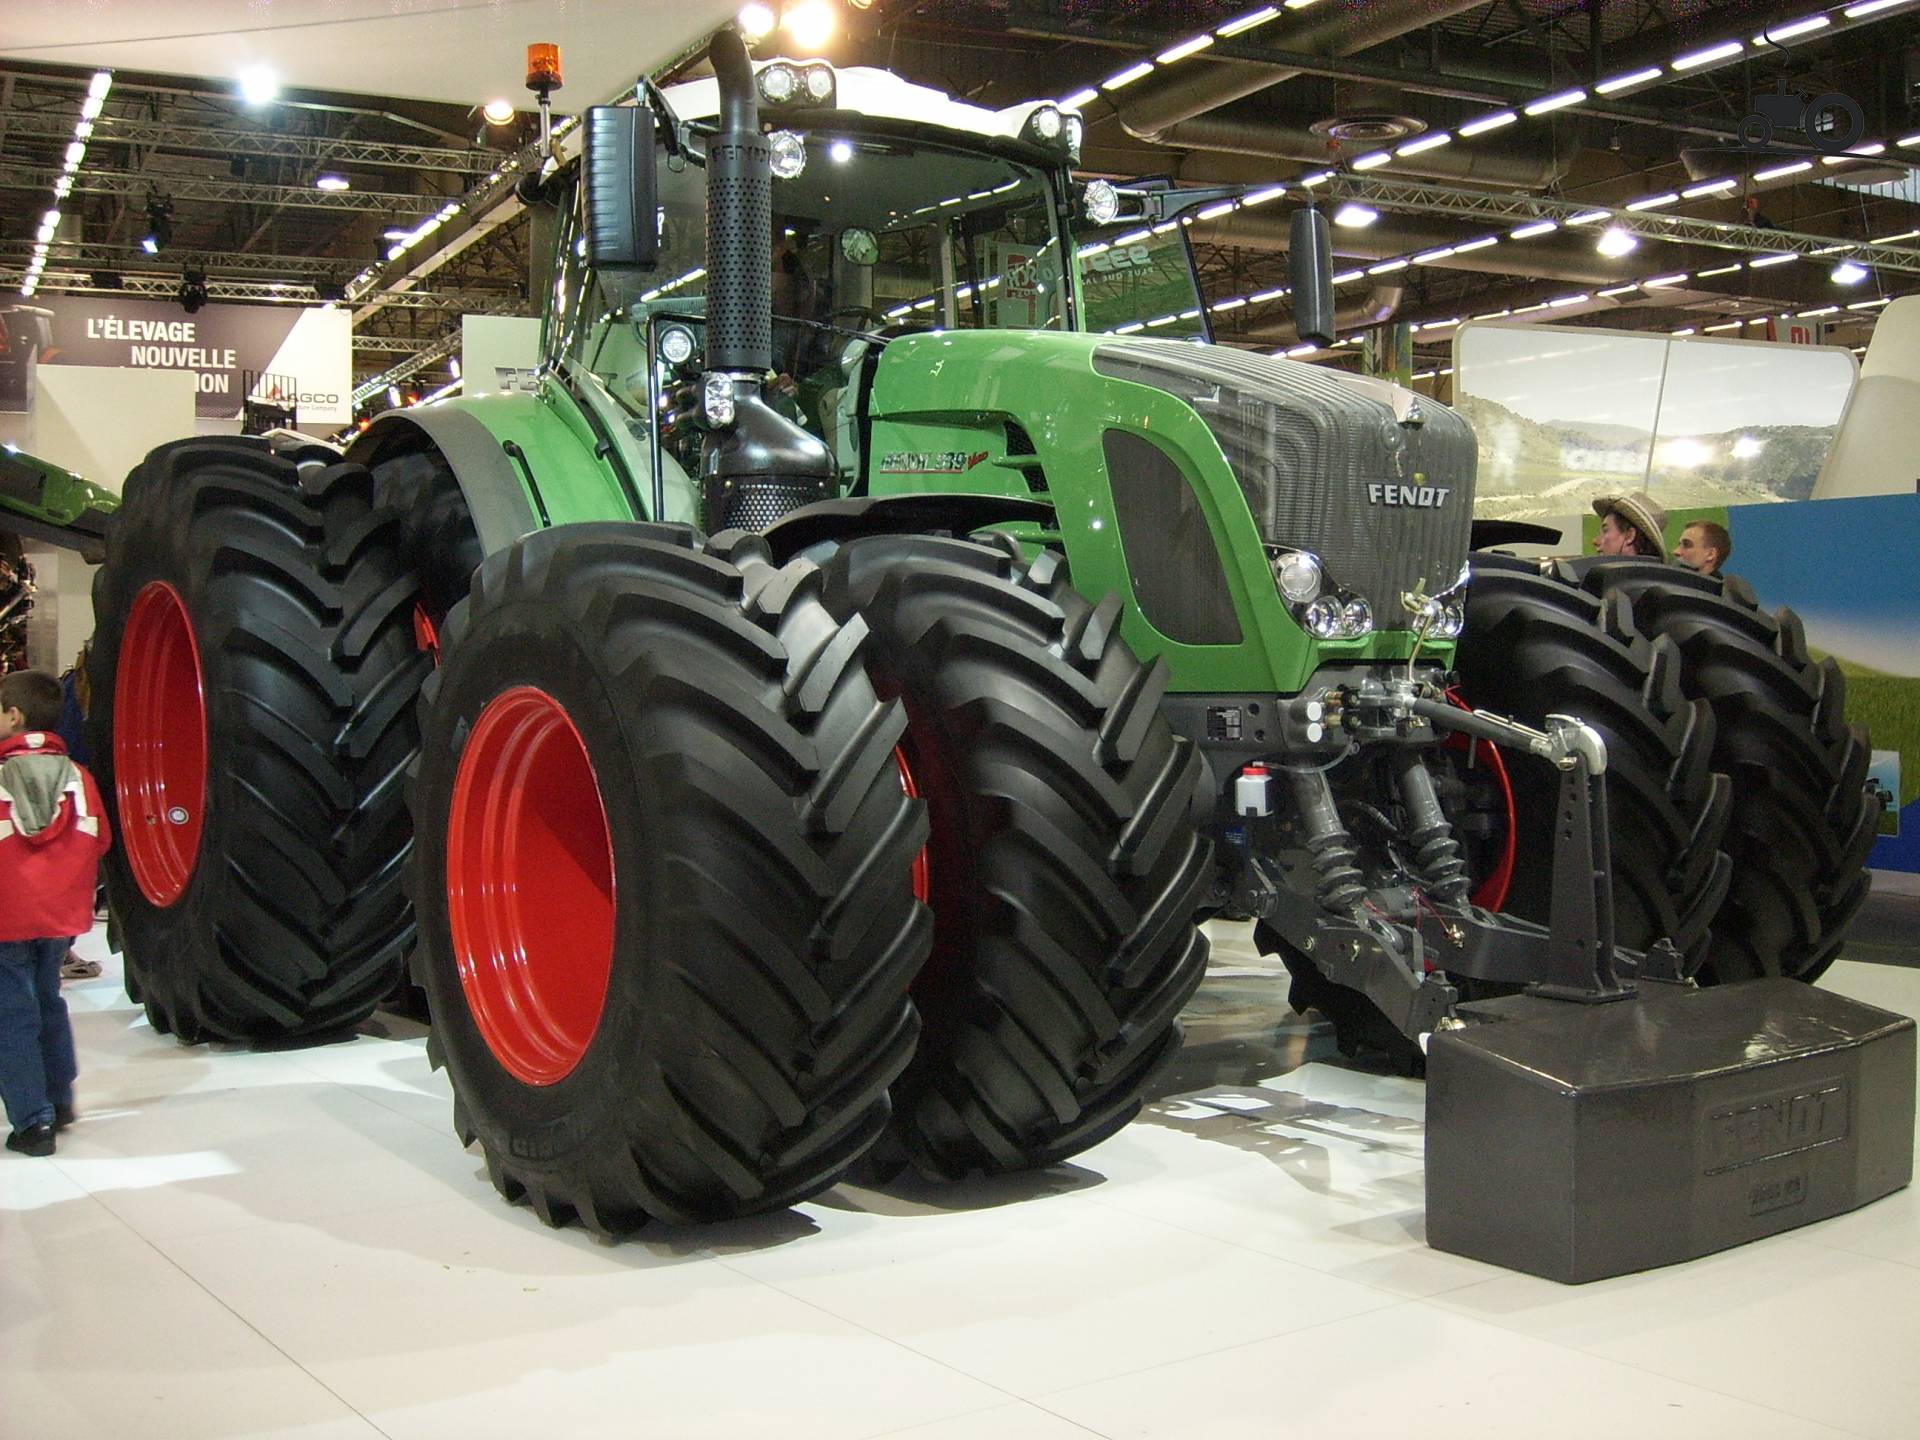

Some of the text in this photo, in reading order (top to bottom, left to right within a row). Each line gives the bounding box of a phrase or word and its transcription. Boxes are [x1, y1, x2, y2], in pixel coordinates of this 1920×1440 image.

[131, 345, 237, 369] NOUVELLE
[286, 393, 339, 404] AGCO
[1368, 484, 1450, 507] FENDT
